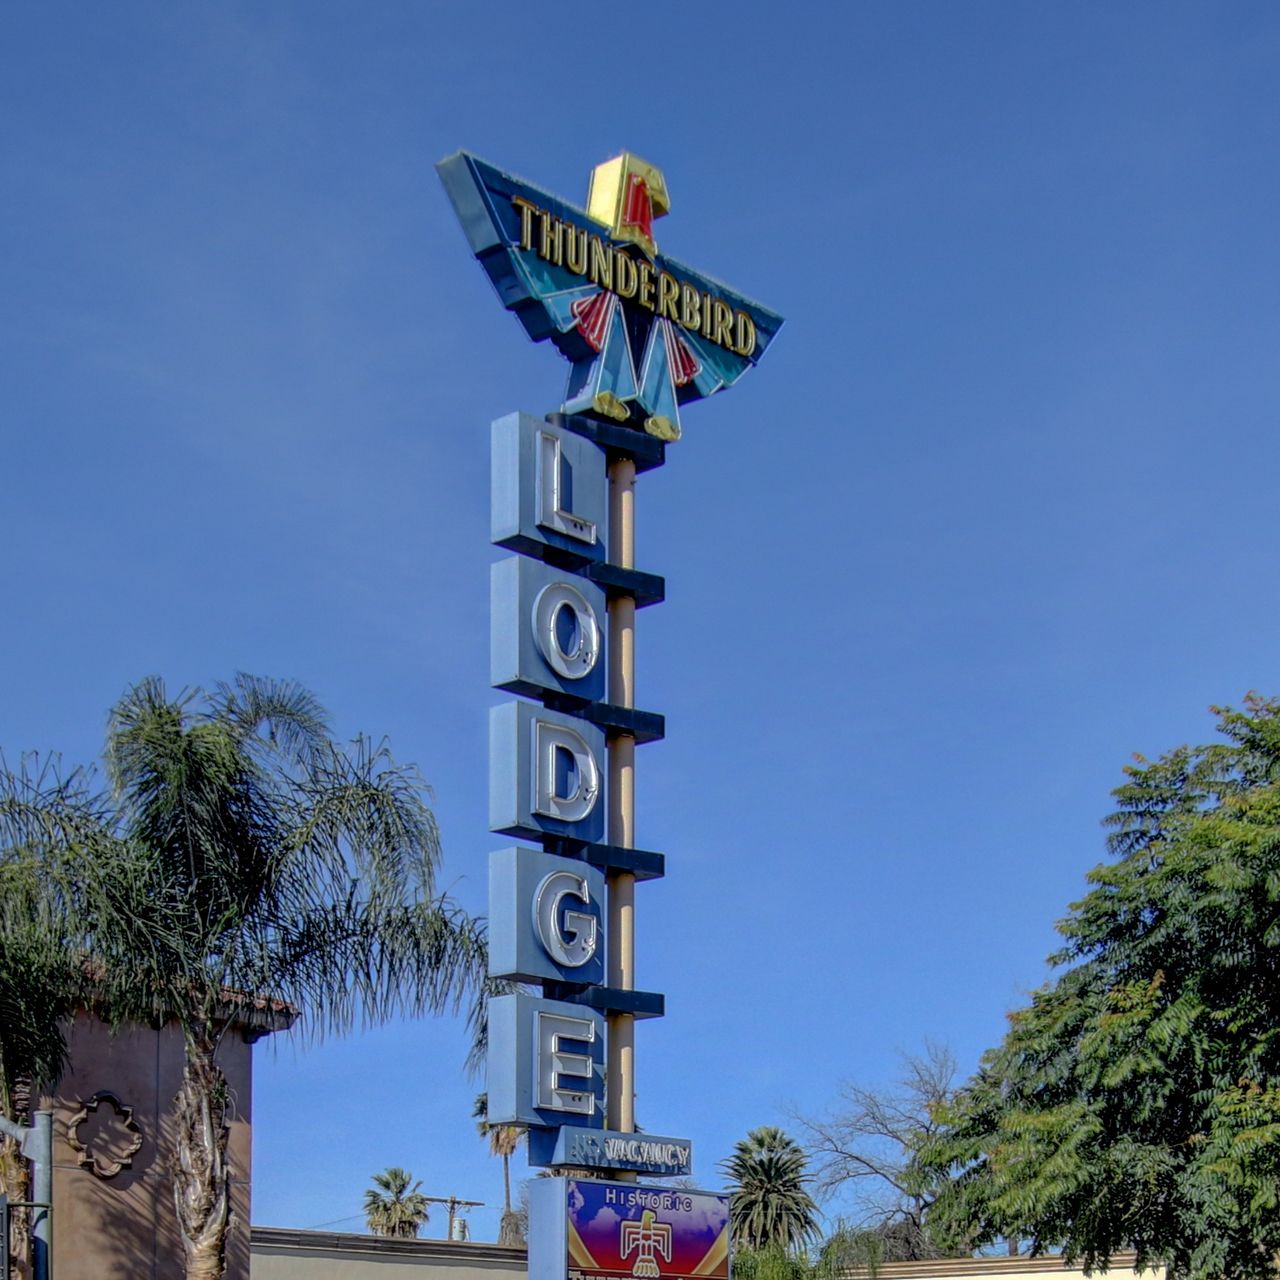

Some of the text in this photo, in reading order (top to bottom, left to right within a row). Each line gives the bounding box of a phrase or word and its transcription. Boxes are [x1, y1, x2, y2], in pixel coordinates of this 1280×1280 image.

[513, 195, 757, 358] THUNDERBIRD
[531, 430, 600, 1115] LODGE
[605, 1139, 689, 1165] VACANCY
[606, 1188, 693, 1212] HISTORIC
